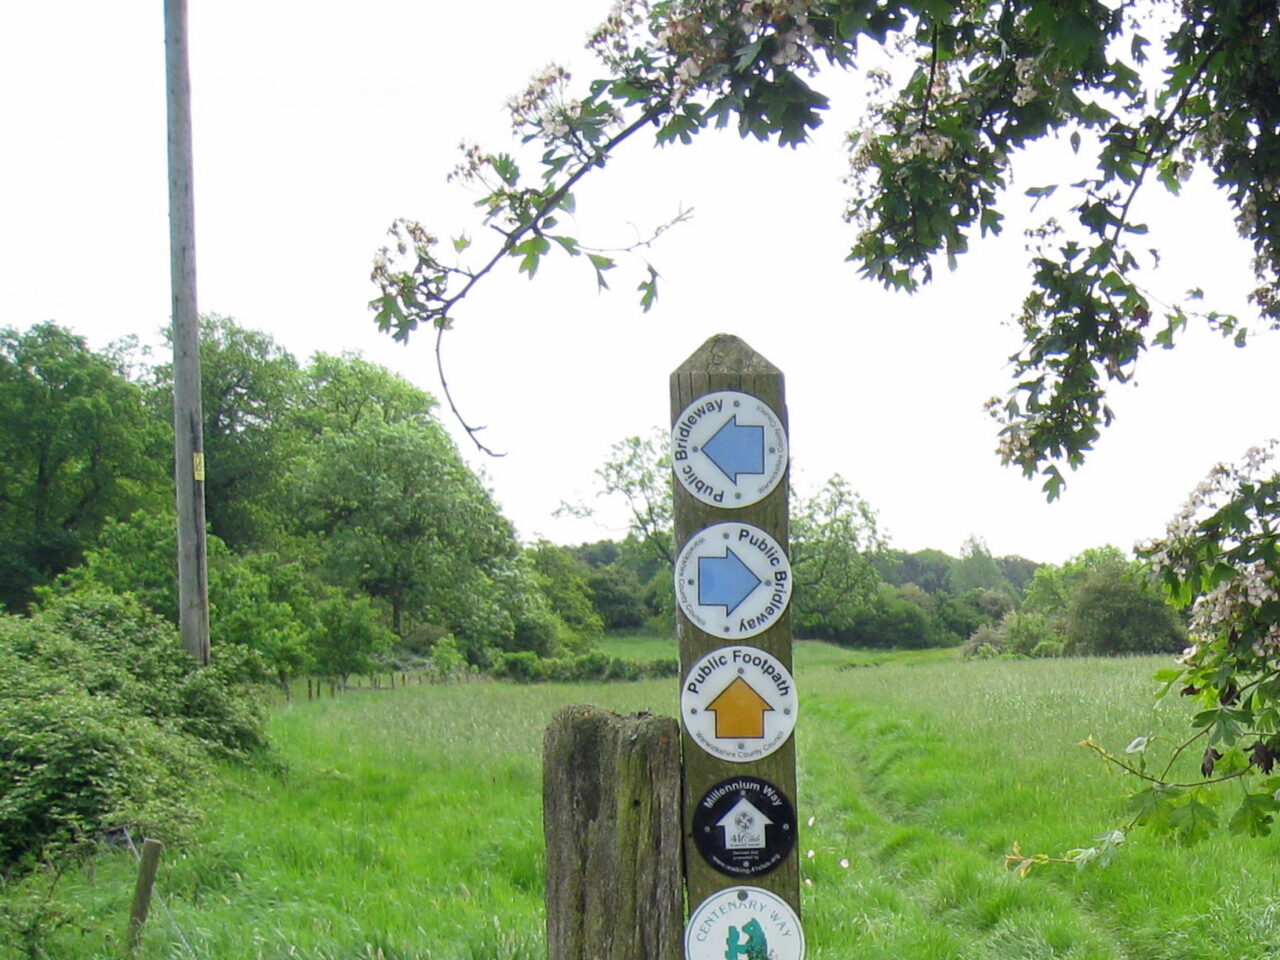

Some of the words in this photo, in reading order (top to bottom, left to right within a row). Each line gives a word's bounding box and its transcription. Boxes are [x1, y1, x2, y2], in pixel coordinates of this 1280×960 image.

[675, 399, 723, 461] Bridleway
[682, 465, 724, 503] Public
[739, 529, 780, 567] Public
[739, 571, 787, 632] Bridleway
[687, 655, 728, 694] Public
[732, 650, 790, 696] Footpath
[703, 781, 760, 809] Millennium
[763, 785, 782, 806] Way
[697, 900, 767, 942] CENTENARY
[770, 910, 792, 937] WAY
